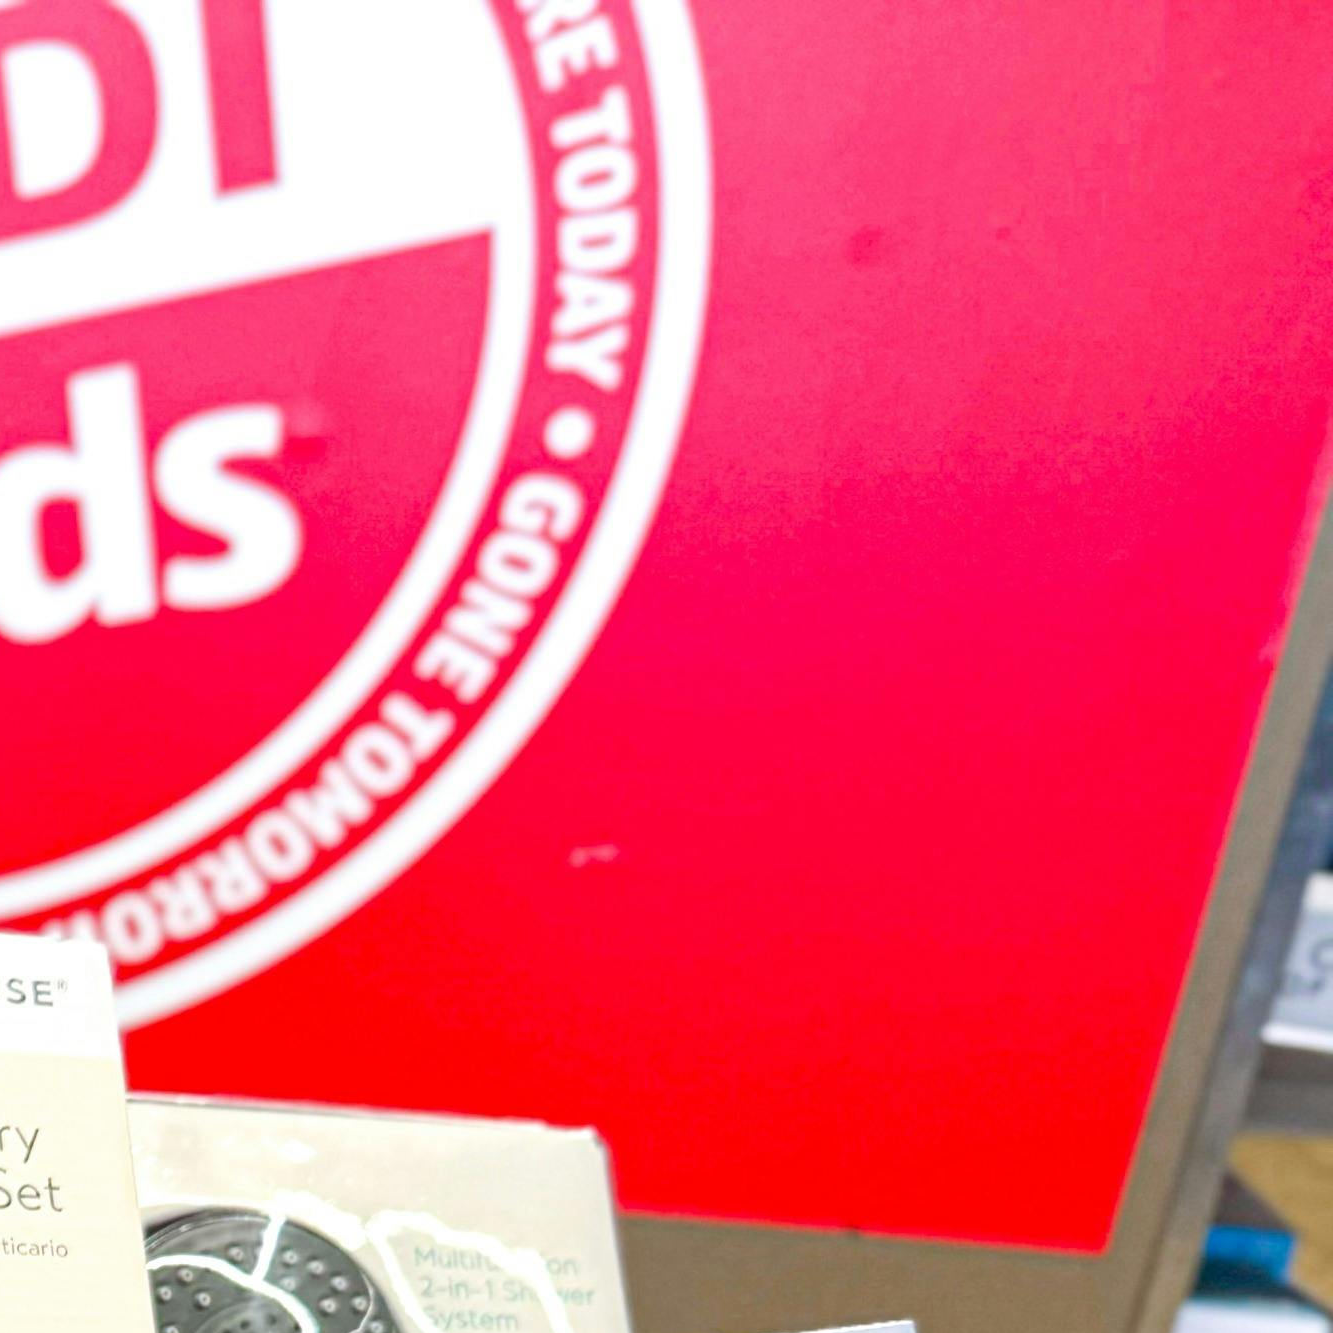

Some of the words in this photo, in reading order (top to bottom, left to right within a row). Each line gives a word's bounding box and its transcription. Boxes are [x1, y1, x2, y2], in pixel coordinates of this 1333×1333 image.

[549, 84, 640, 391] TODAY
[411, 471, 585, 705] GONE
[39, 688, 456, 966] TOMORRO
[501, 1280, 596, 1307] Shwer
